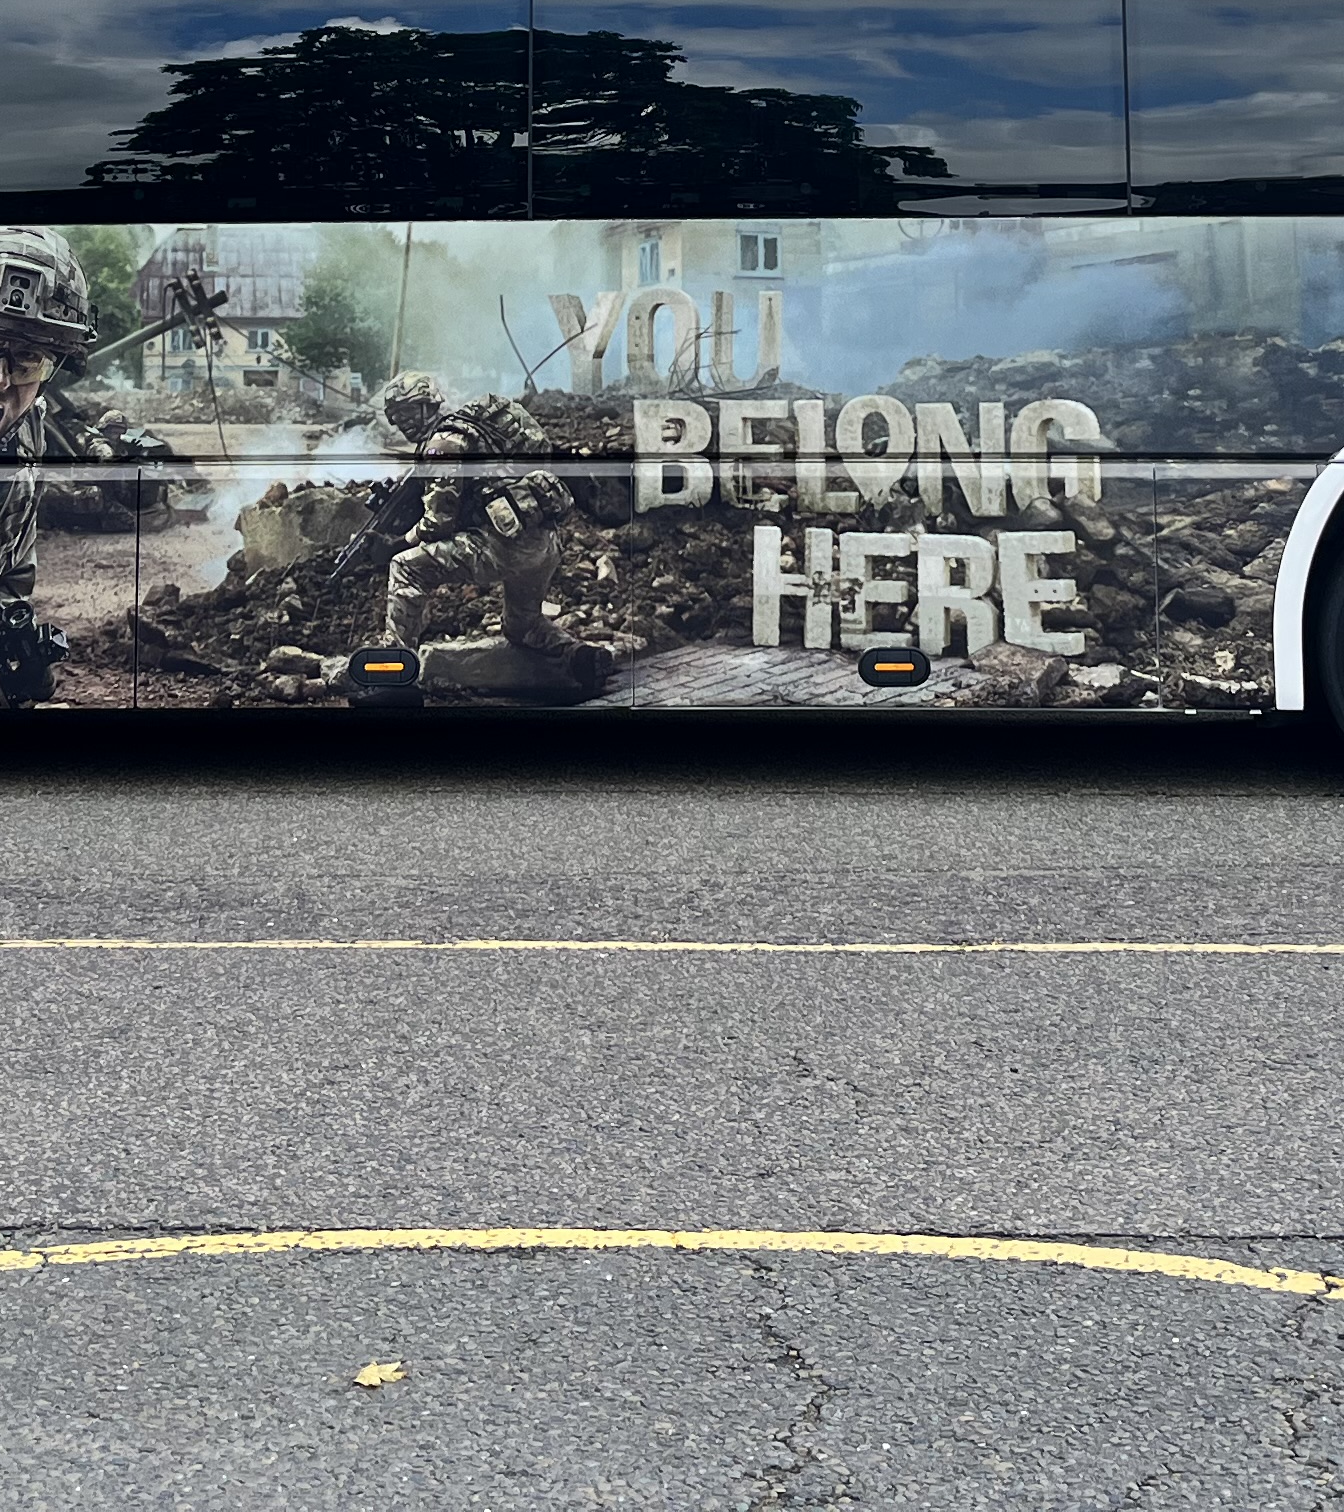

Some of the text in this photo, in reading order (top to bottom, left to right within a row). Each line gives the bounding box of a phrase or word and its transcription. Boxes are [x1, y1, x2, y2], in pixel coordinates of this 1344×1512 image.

[549, 288, 782, 392] YOU
[632, 395, 1102, 517] BELONG
[752, 525, 1086, 656] HERE
